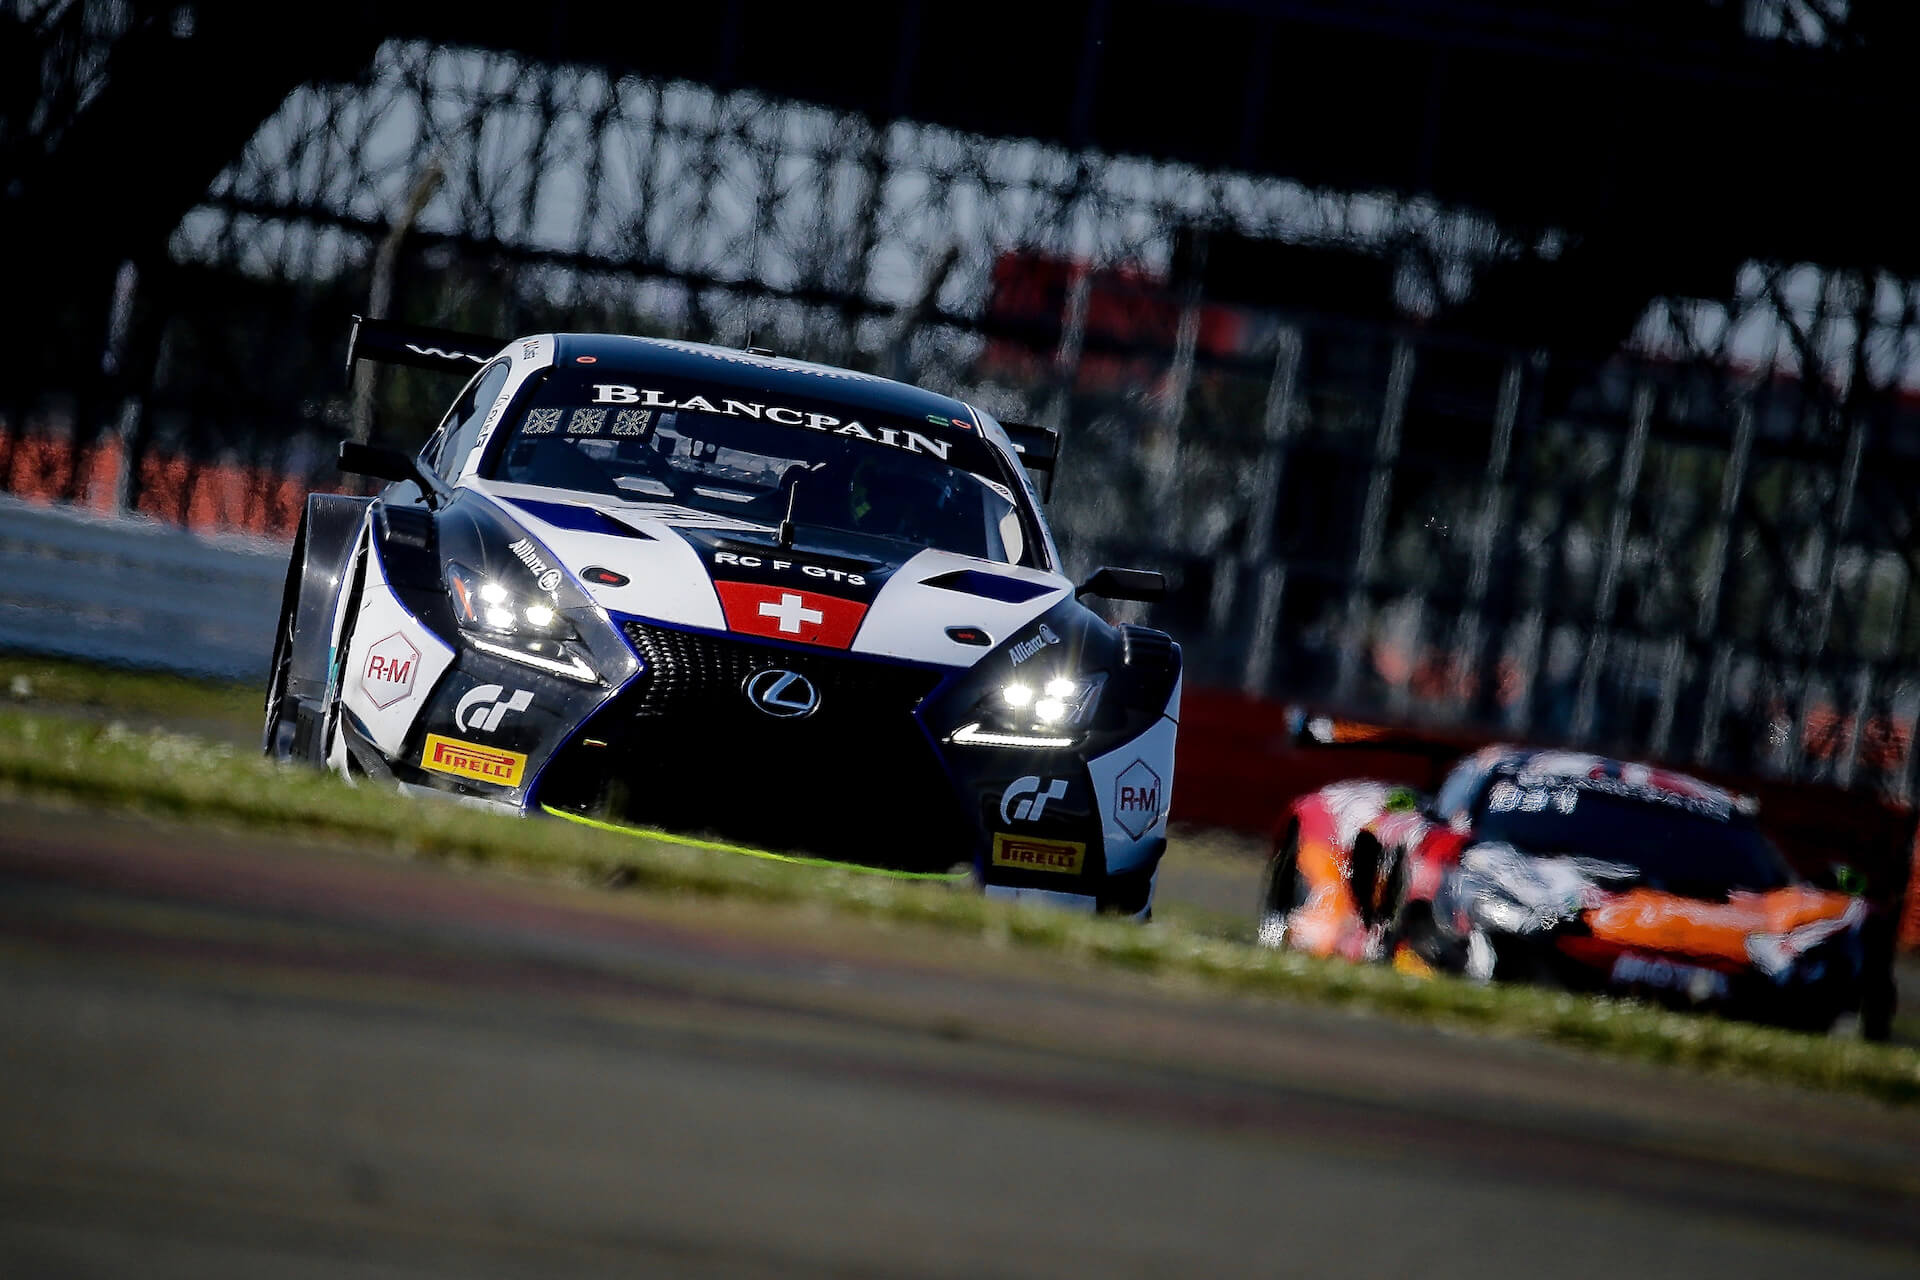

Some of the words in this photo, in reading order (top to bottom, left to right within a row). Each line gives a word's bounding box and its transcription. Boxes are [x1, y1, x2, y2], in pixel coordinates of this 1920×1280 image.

[592, 384, 952, 460] BLANCPAIN
[508, 537, 548, 577] Allianz
[714, 551, 762, 568] RC
[773, 559, 792, 571] F
[801, 565, 866, 586] GT3
[1009, 634, 1047, 667] Allianz
[368, 655, 411, 684] R-M
[433, 742, 516, 779] PIRELLI
[1120, 786, 1156, 812] R-M
[1000, 838, 1078, 868] PIRELLI
